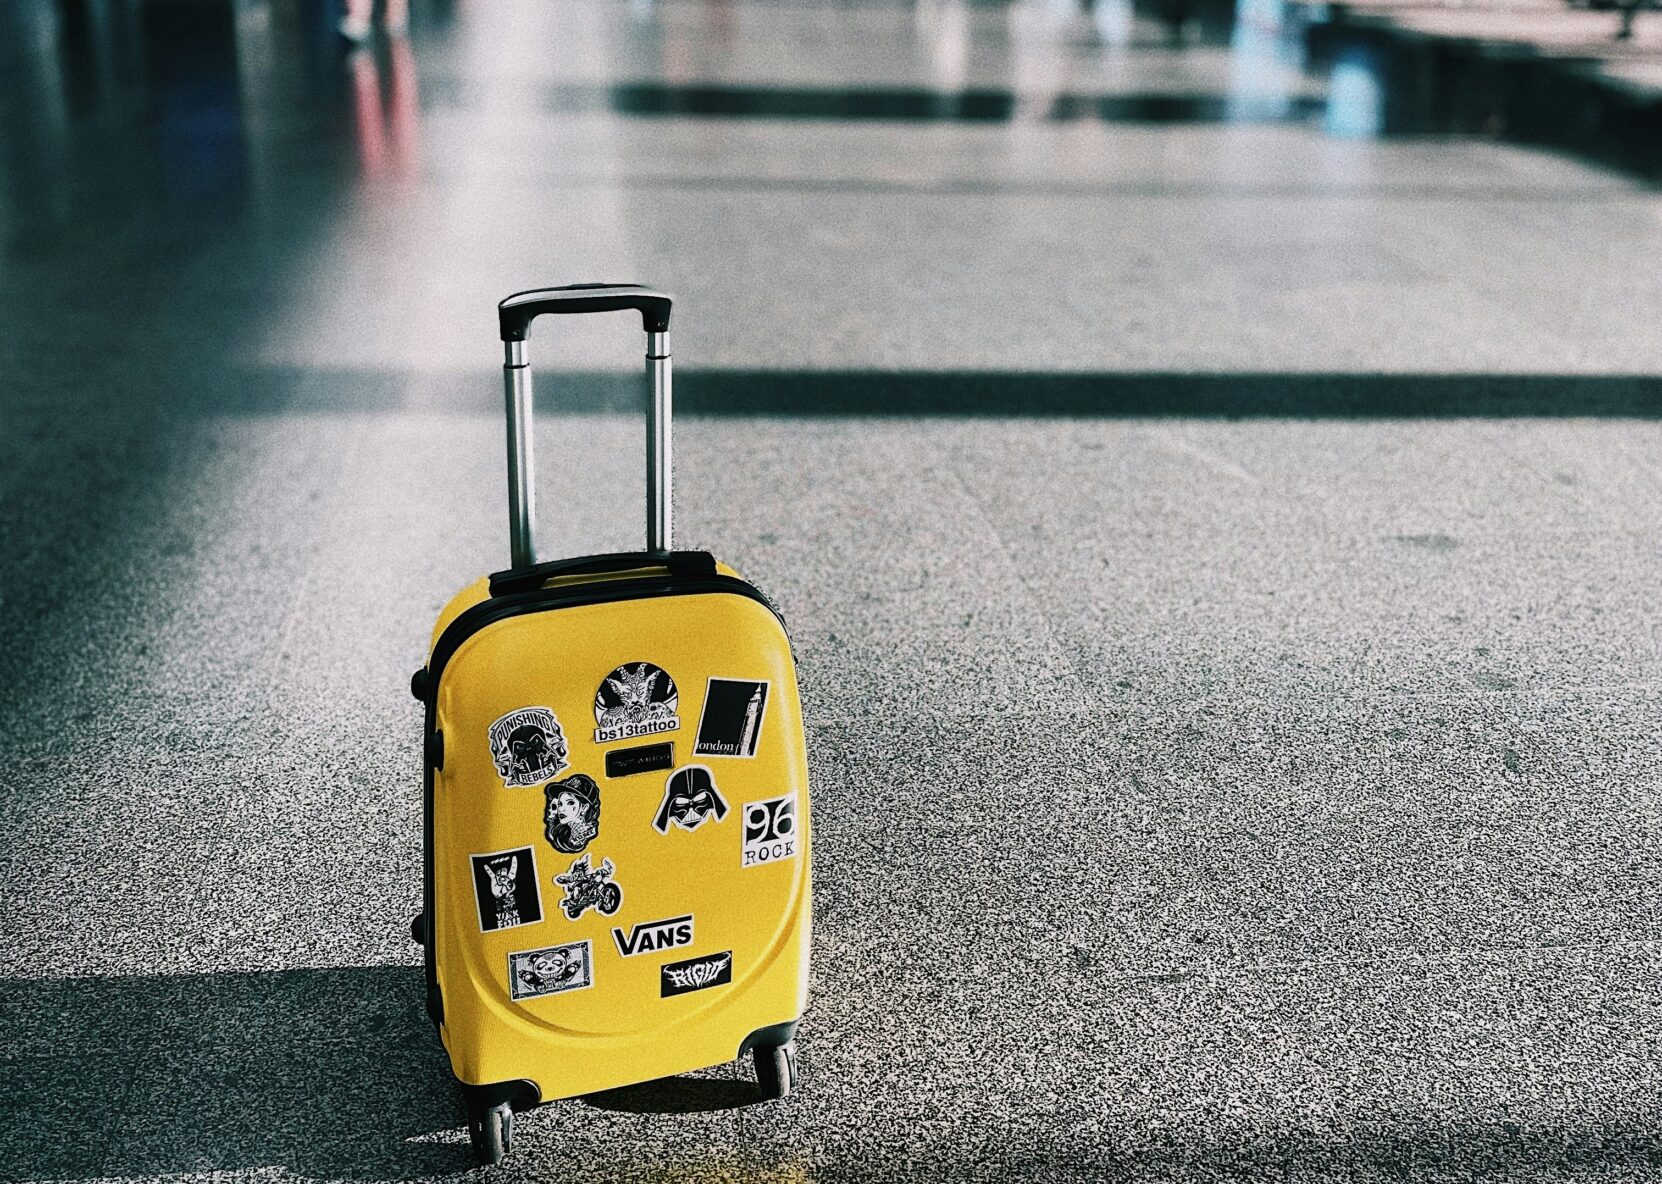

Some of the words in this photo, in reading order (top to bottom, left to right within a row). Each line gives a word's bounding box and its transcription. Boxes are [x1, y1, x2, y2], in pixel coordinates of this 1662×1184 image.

[496, 712, 552, 748] PUNISHING
[599, 719, 676, 741] bs13tattoo
[697, 739, 734, 751] ondon
[520, 765, 553, 783] REBELS
[743, 793, 794, 843] 96
[744, 841, 794, 866] ROCK
[613, 914, 693, 956] VANS
